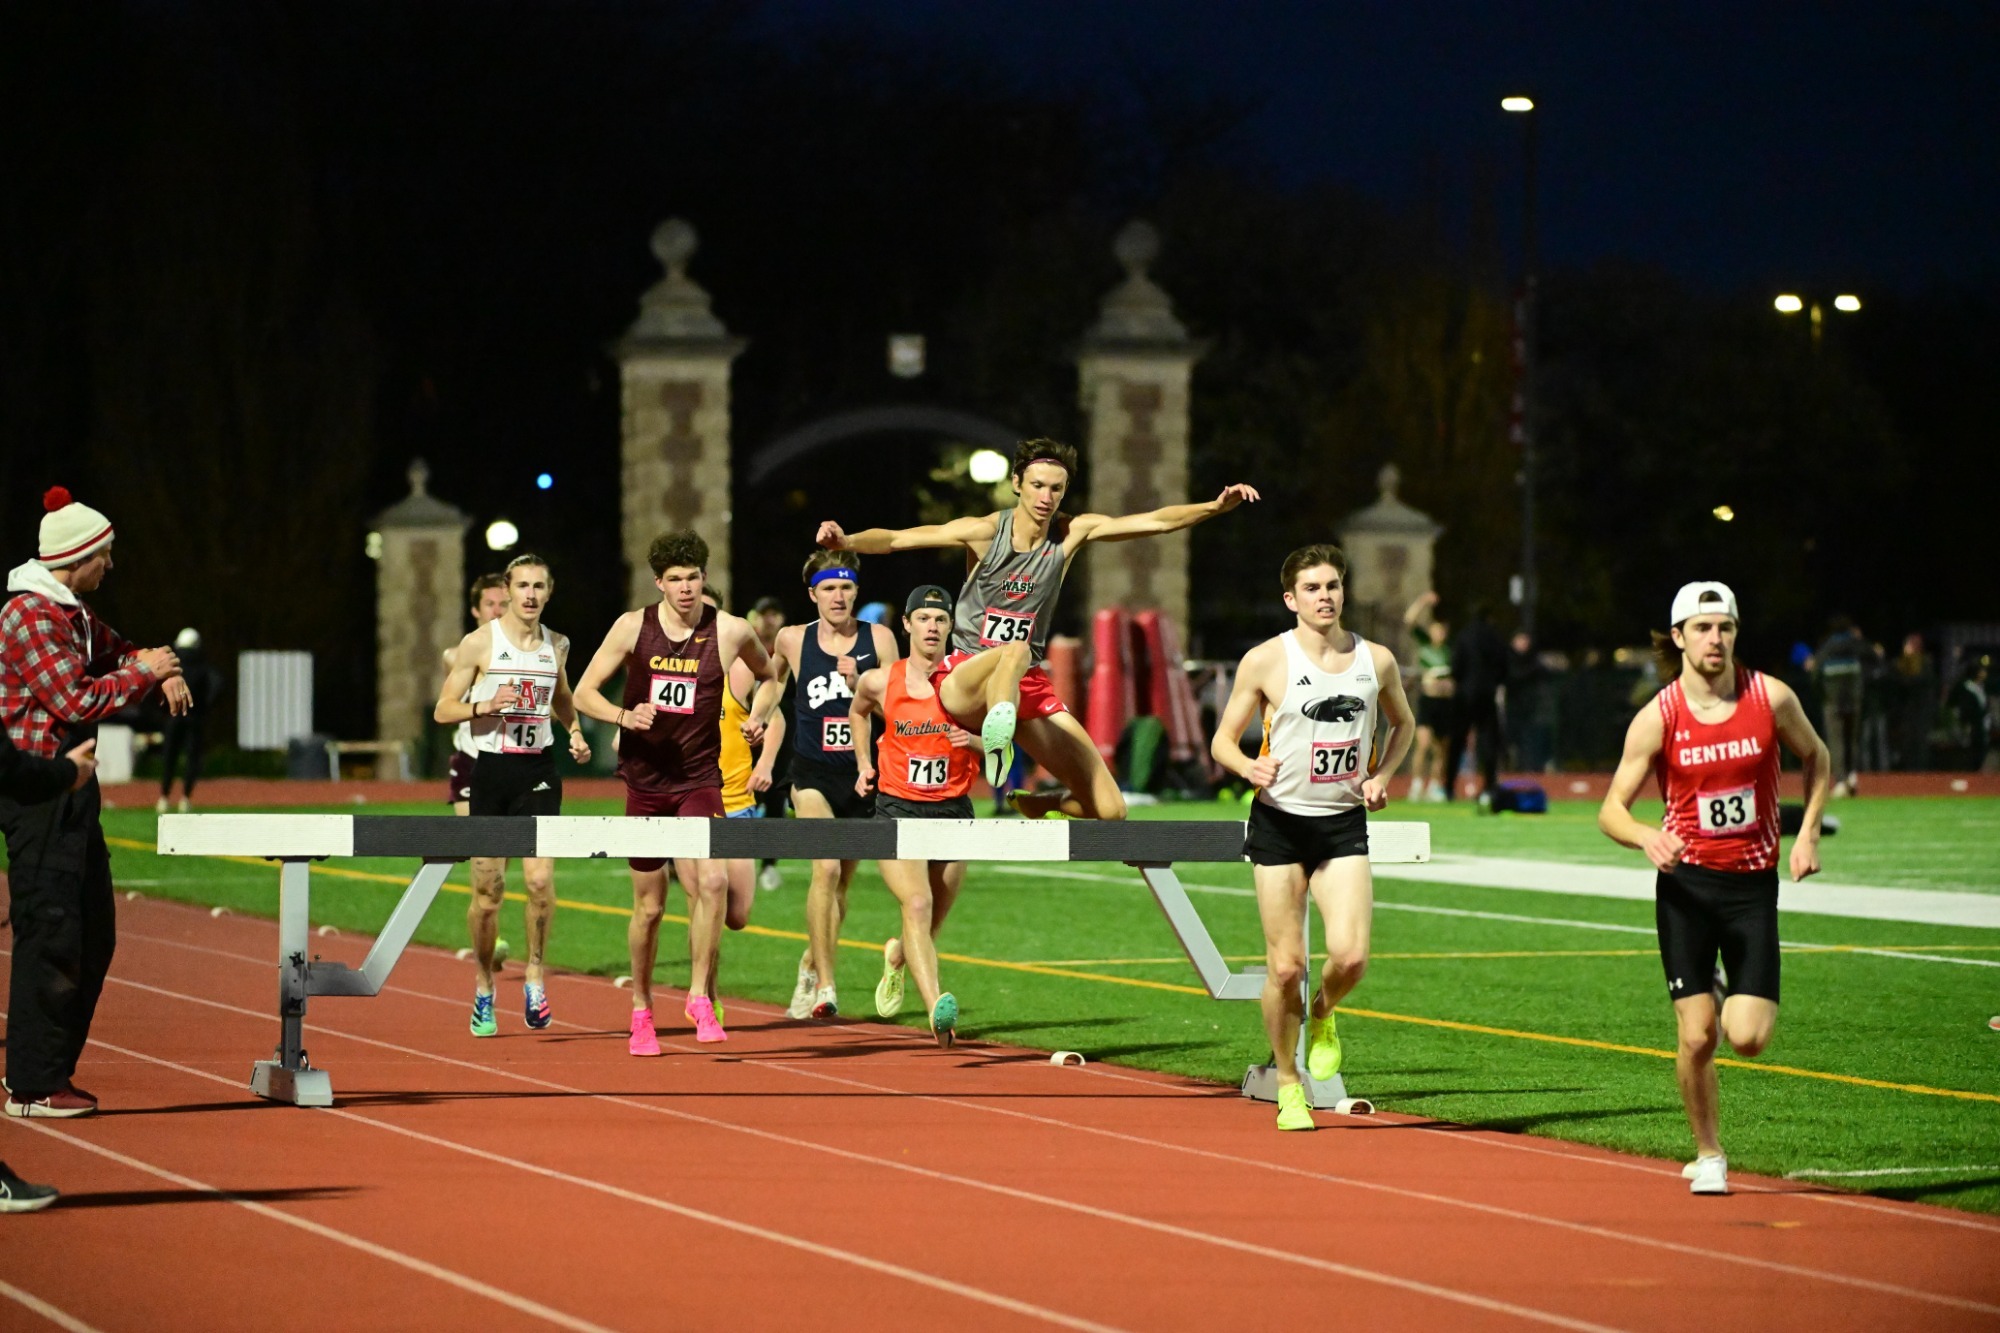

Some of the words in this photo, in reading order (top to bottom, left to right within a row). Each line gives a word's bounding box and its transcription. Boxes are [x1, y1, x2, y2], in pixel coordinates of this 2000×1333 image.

[1001, 579, 1035, 595] WASH
[987, 615, 1031, 642] 735
[649, 655, 701, 673] CALVIN
[658, 681, 686, 707] 40
[806, 670, 855, 710] SA
[513, 724, 537, 748] 15
[1314, 746, 1358, 775] 376
[1679, 736, 1762, 766] CENTRAL
[910, 759, 946, 784] 713
[1709, 795, 1746, 827] 83
